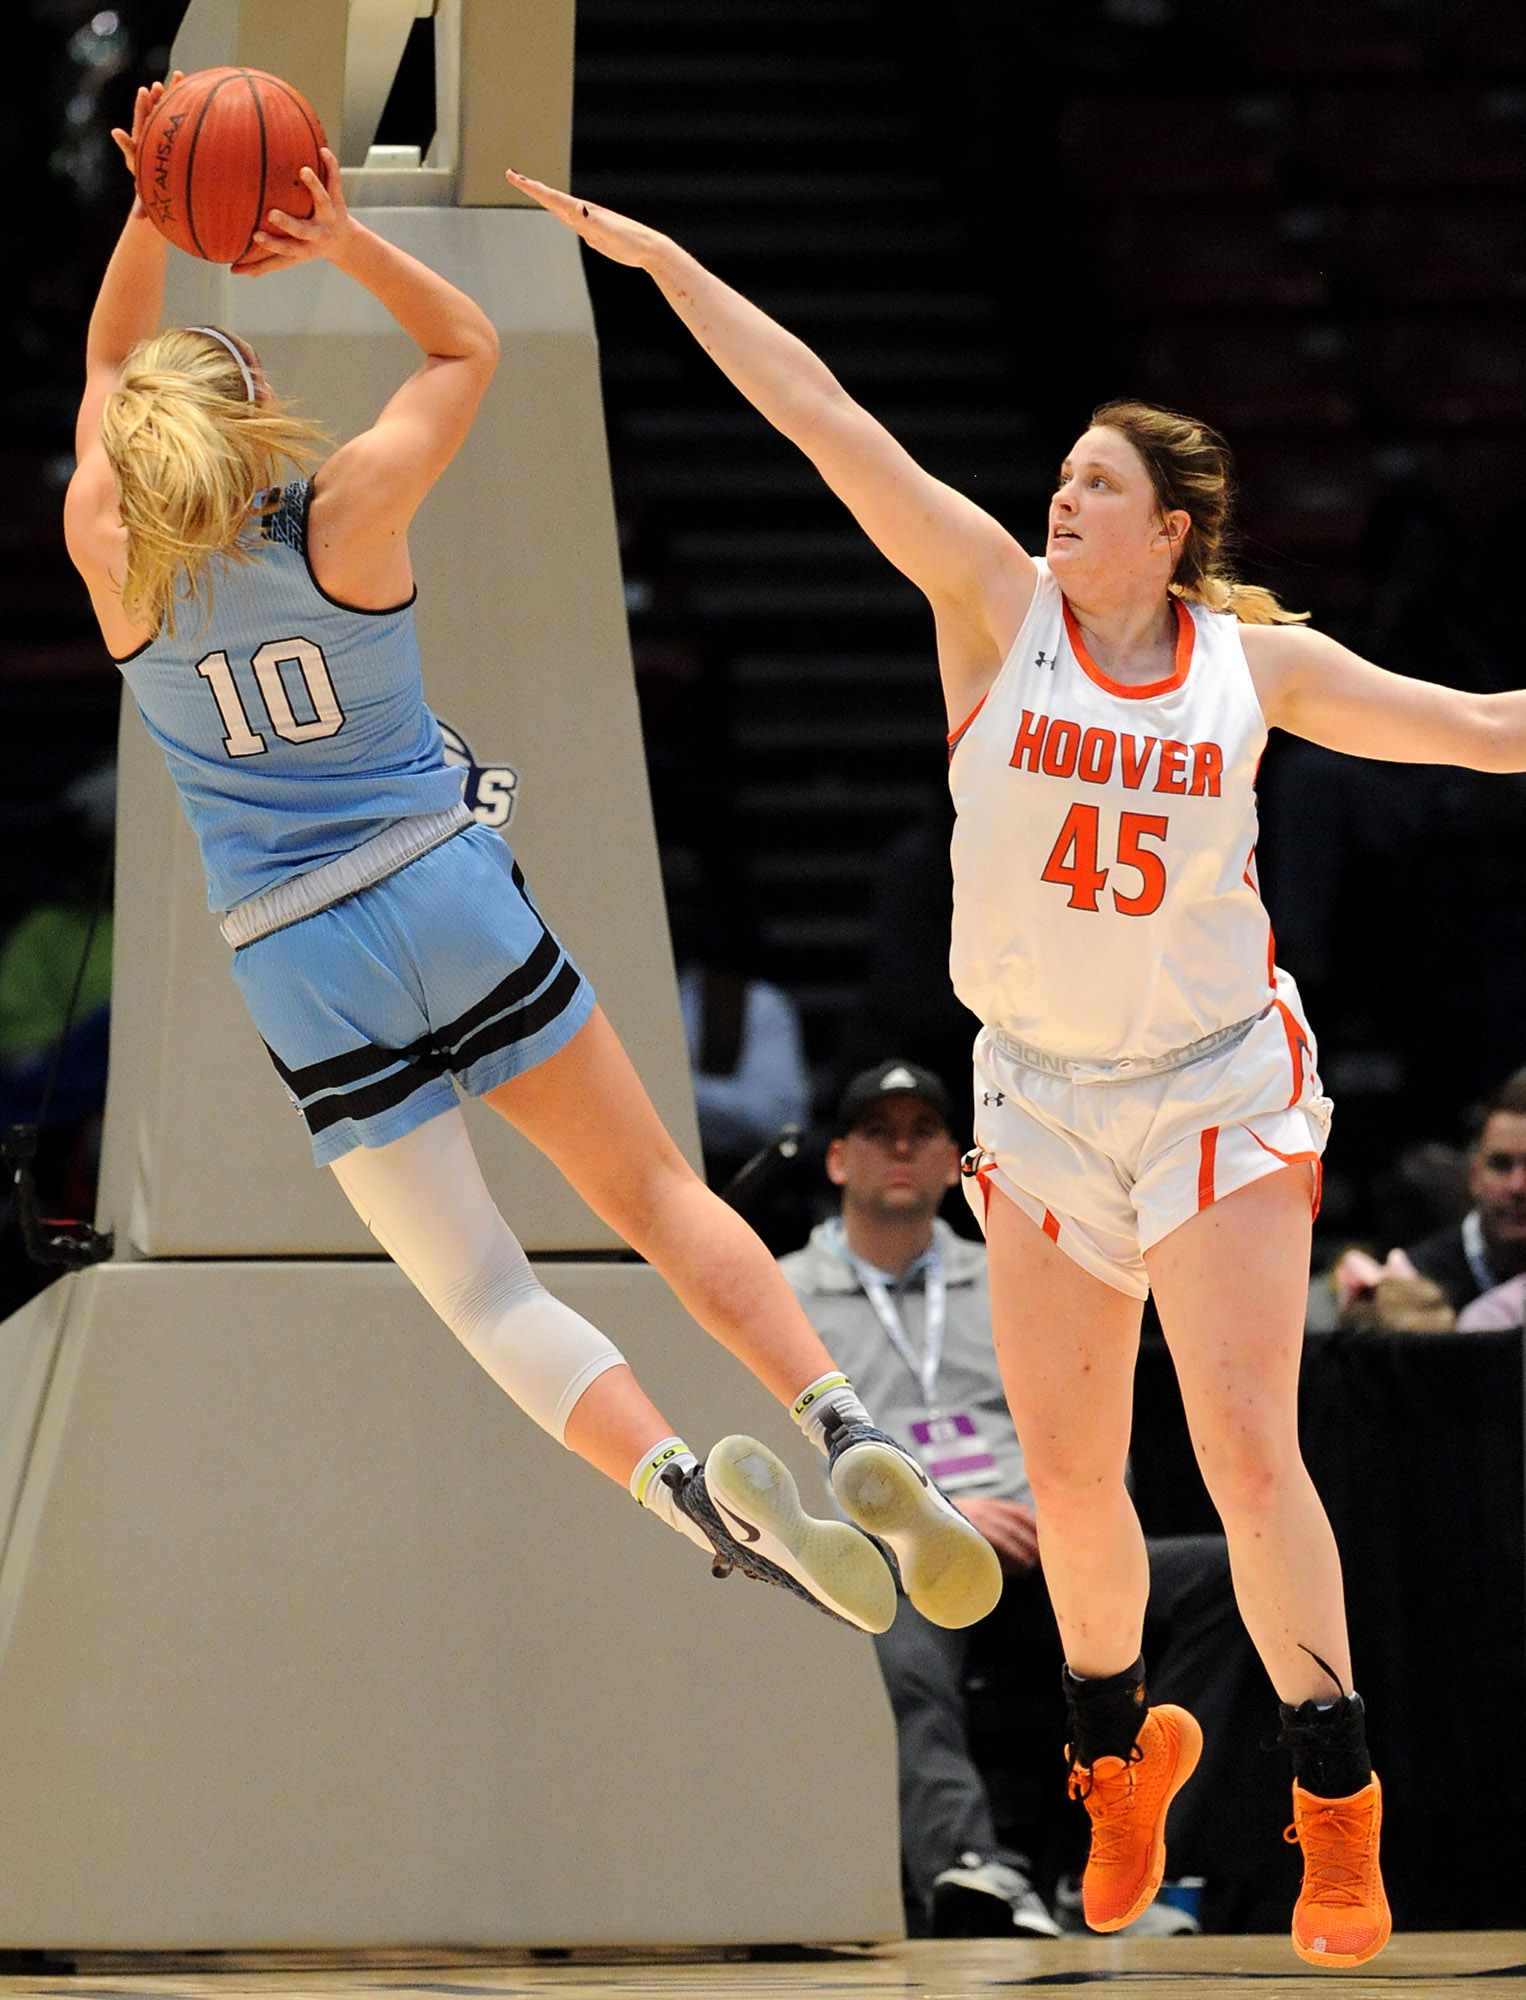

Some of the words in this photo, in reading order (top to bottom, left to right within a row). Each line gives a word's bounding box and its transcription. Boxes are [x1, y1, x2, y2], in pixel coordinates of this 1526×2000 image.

[155, 112, 186, 191] AHSAA
[195, 636, 346, 759] 10
[466, 767, 517, 828] S
[1009, 710, 1223, 798] HOOVER
[1041, 802, 1169, 917] 45
